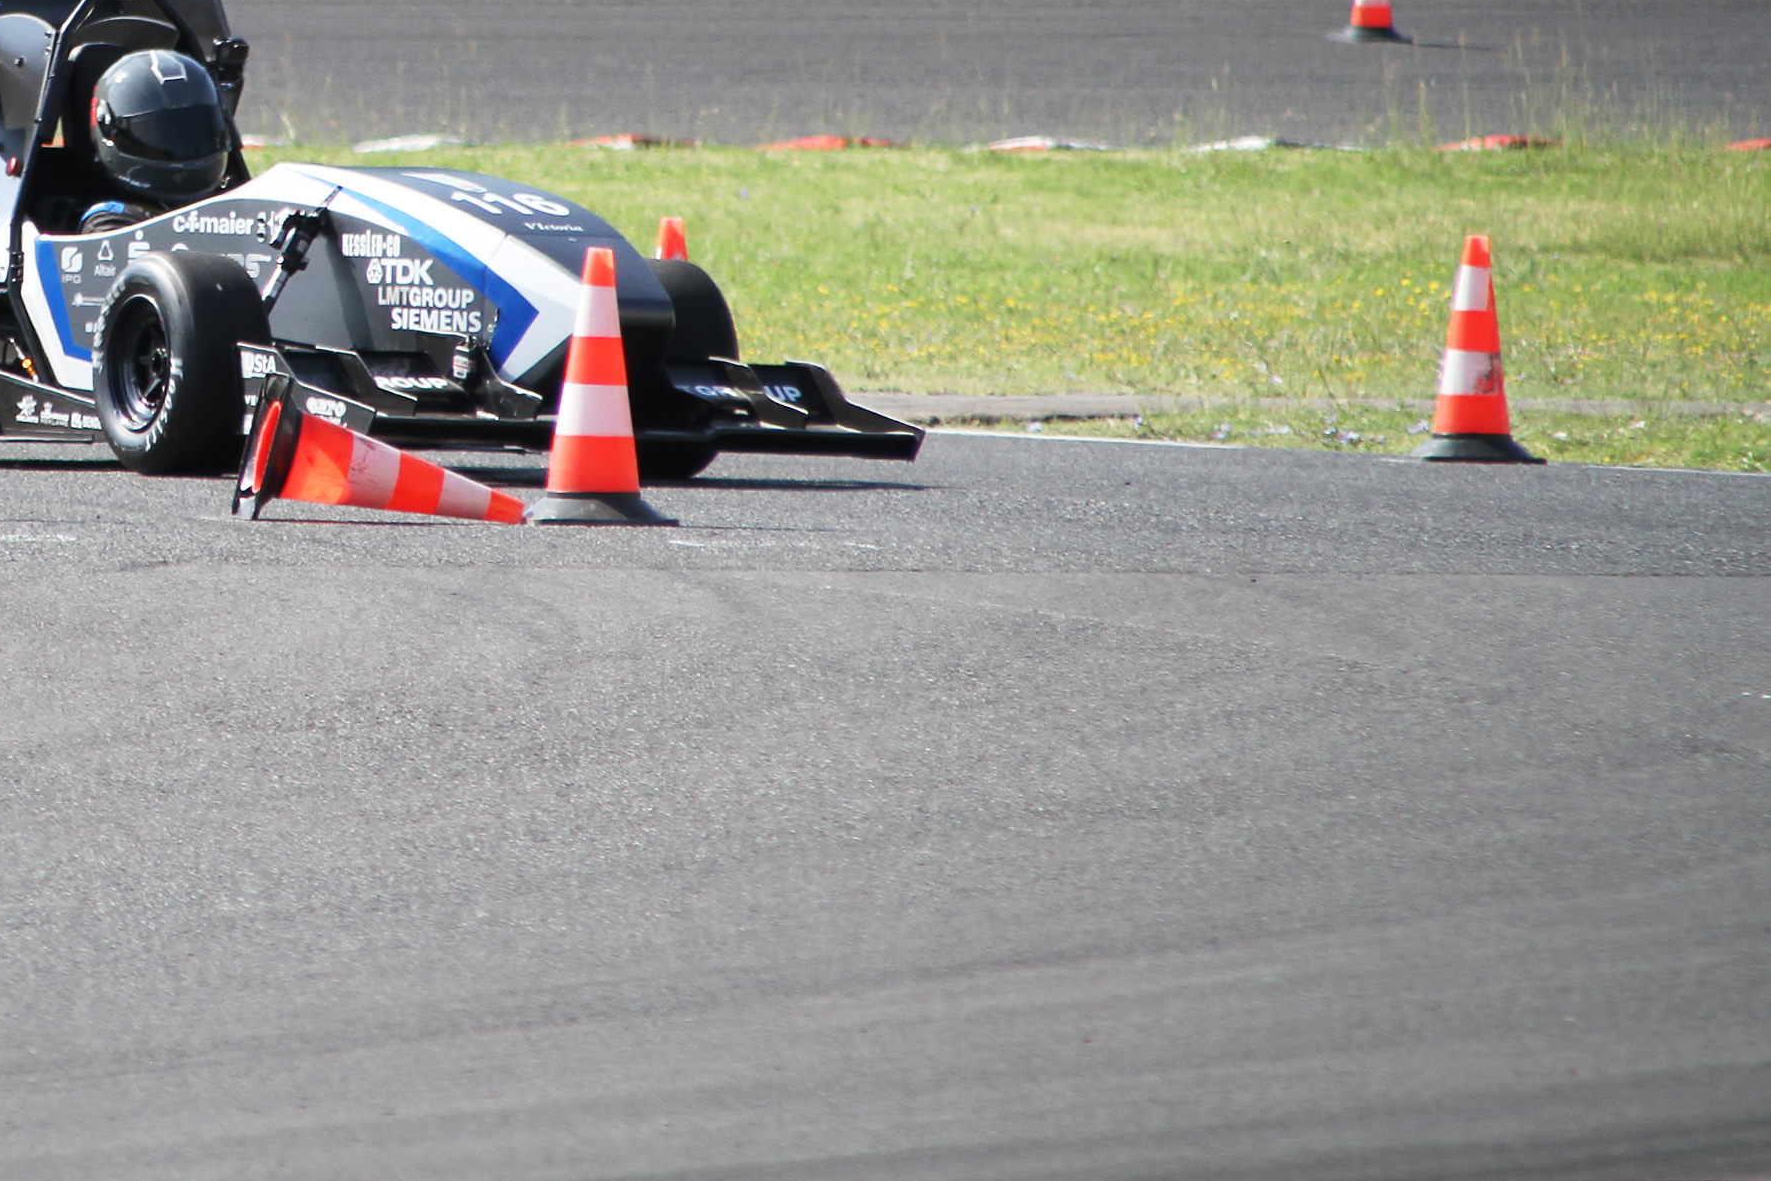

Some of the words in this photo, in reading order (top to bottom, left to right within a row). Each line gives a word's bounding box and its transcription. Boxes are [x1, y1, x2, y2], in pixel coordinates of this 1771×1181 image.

[450, 190, 571, 217] 116
[61, 275, 82, 285] IPG
[93, 265, 117, 278] Altair
[379, 258, 434, 286] TDK
[378, 285, 475, 310] LMTGROUP
[391, 307, 482, 333] SIEMENS
